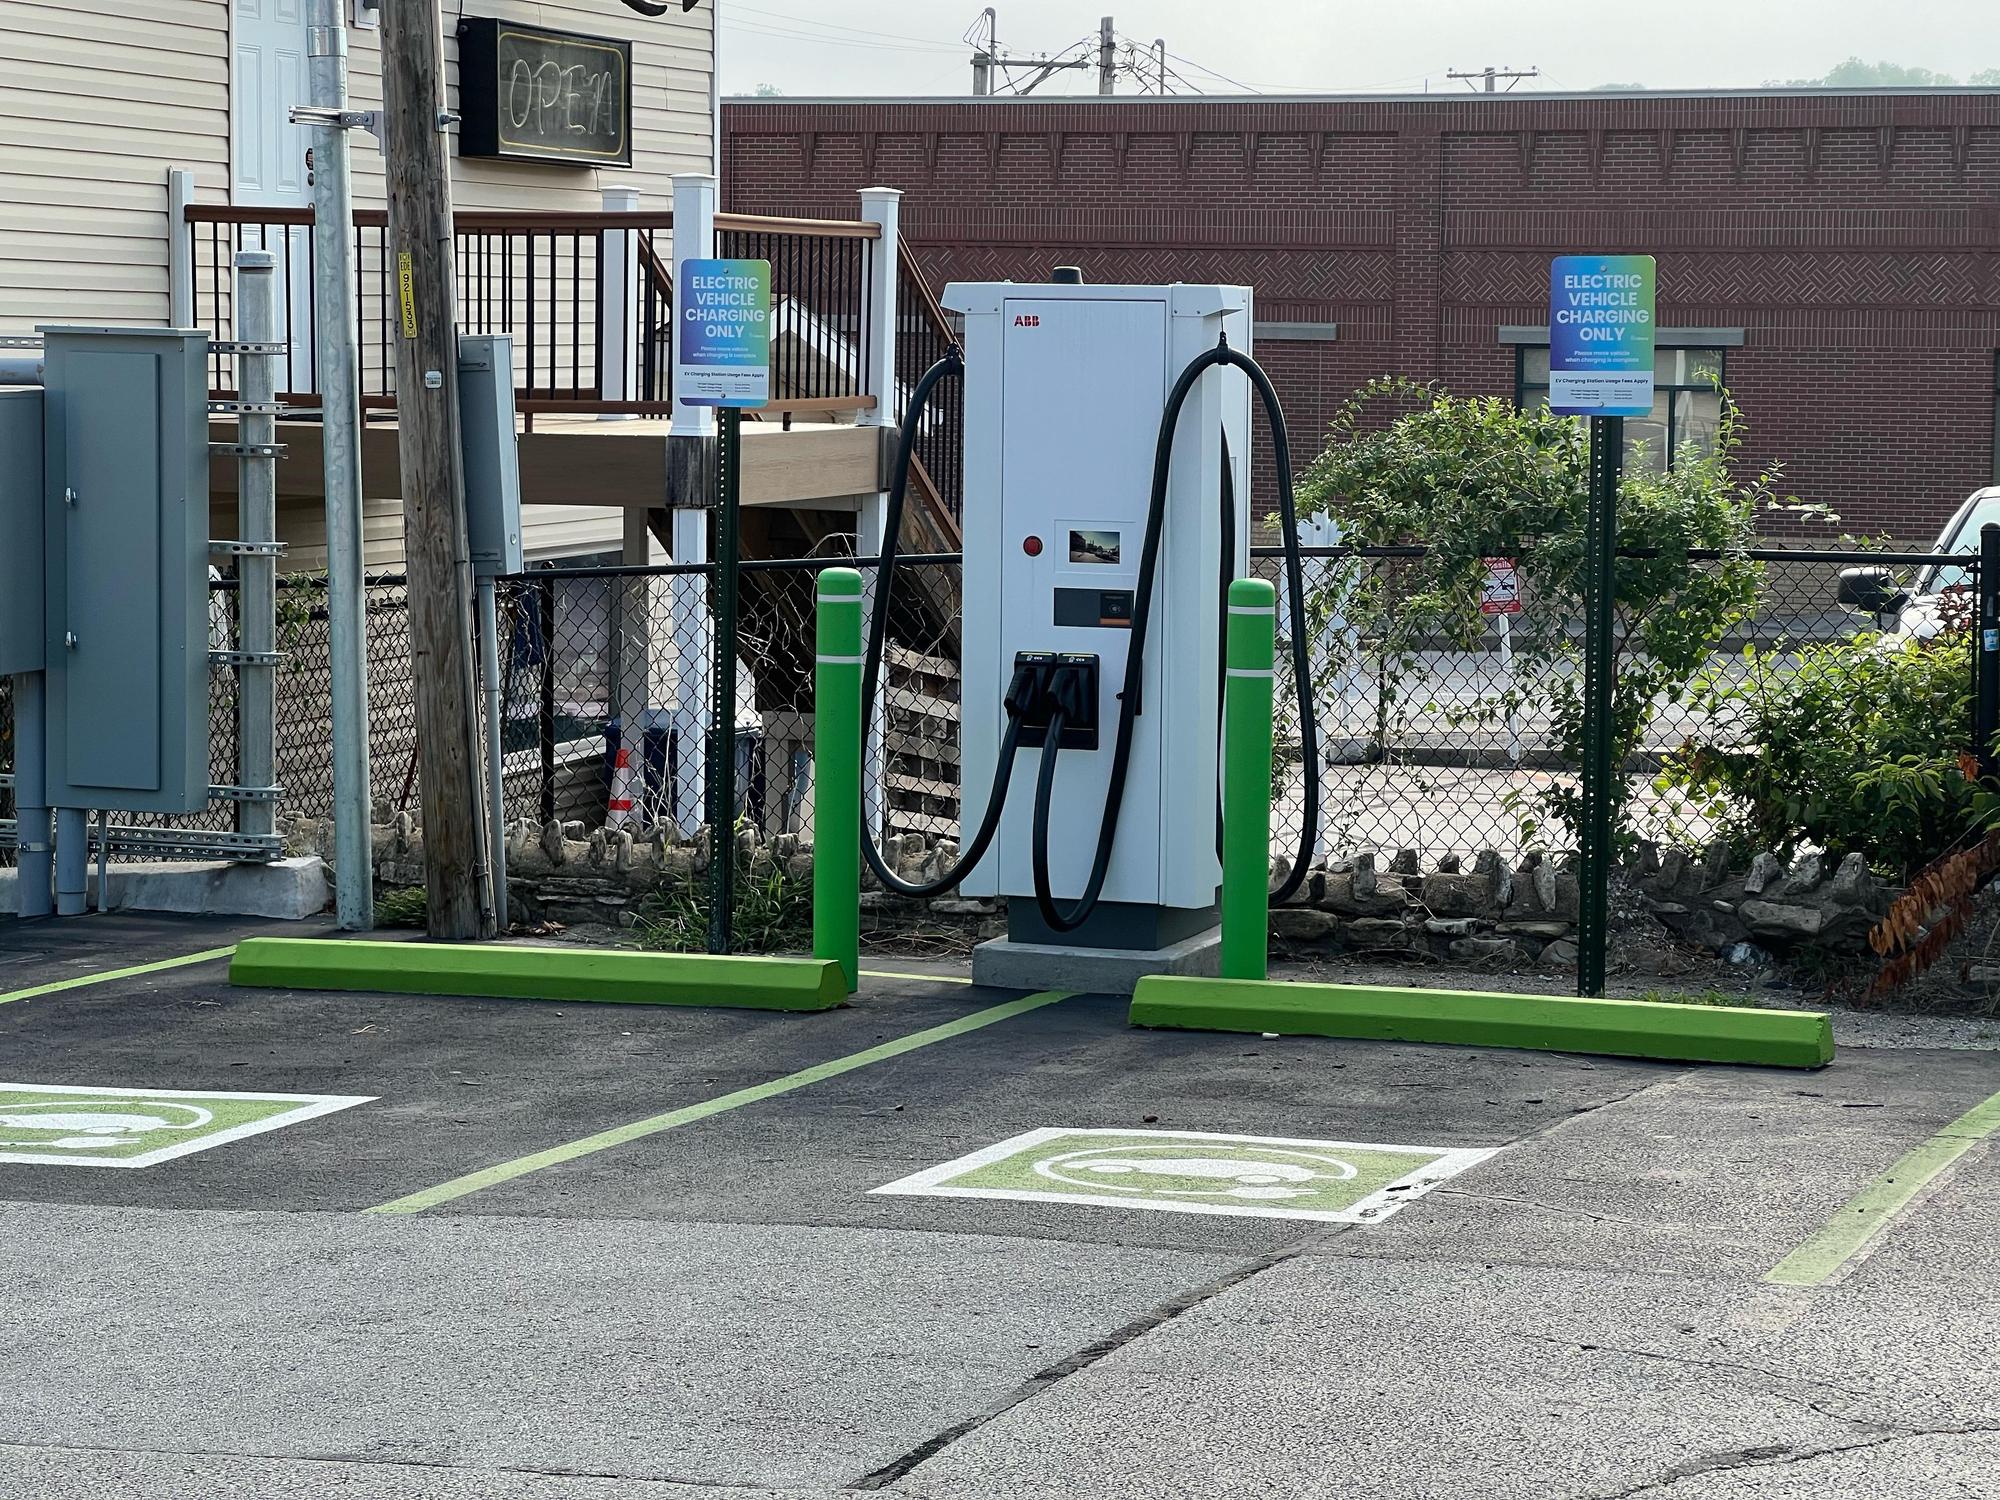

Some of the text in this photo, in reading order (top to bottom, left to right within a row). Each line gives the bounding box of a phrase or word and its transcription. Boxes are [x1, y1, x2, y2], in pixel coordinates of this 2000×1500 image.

[510, 58, 615, 136] OPEN
[692, 276, 759, 289] ELECTRIC
[1564, 274, 1642, 289] ELECTRIC
[696, 292, 755, 306] VEHICLE
[1569, 292, 1637, 306] VEHICLE
[685, 308, 765, 322] CHARGING
[1014, 315, 1040, 327] ABB
[1556, 309, 1649, 324] CHARGING
[705, 325, 744, 338] ONLY
[1580, 327, 1625, 341] ONLY
